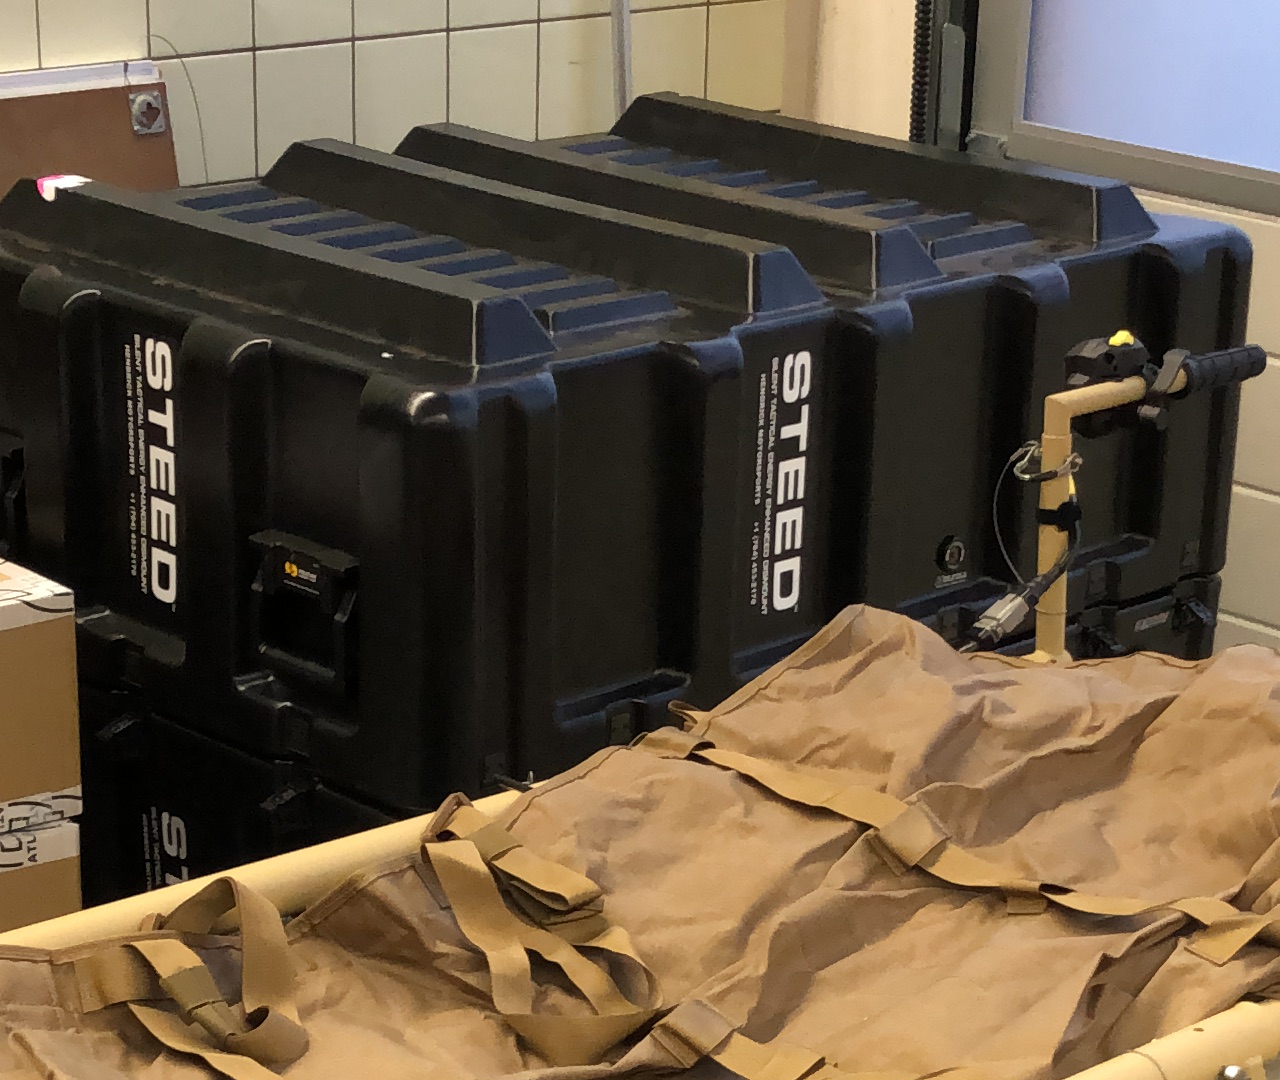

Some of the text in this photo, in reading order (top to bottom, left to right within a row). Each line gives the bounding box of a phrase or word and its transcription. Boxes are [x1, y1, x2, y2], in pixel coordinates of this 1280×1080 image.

[134, 333, 142, 372] SILENT
[770, 356, 780, 395] SILENT
[136, 375, 145, 427] TACTICAL
[768, 397, 778, 450] TACTICAL
[138, 428, 147, 474] ENERGY
[145, 338, 177, 604] STEED
[766, 451, 775, 495] ENERGY
[773, 350, 812, 611] STEED
